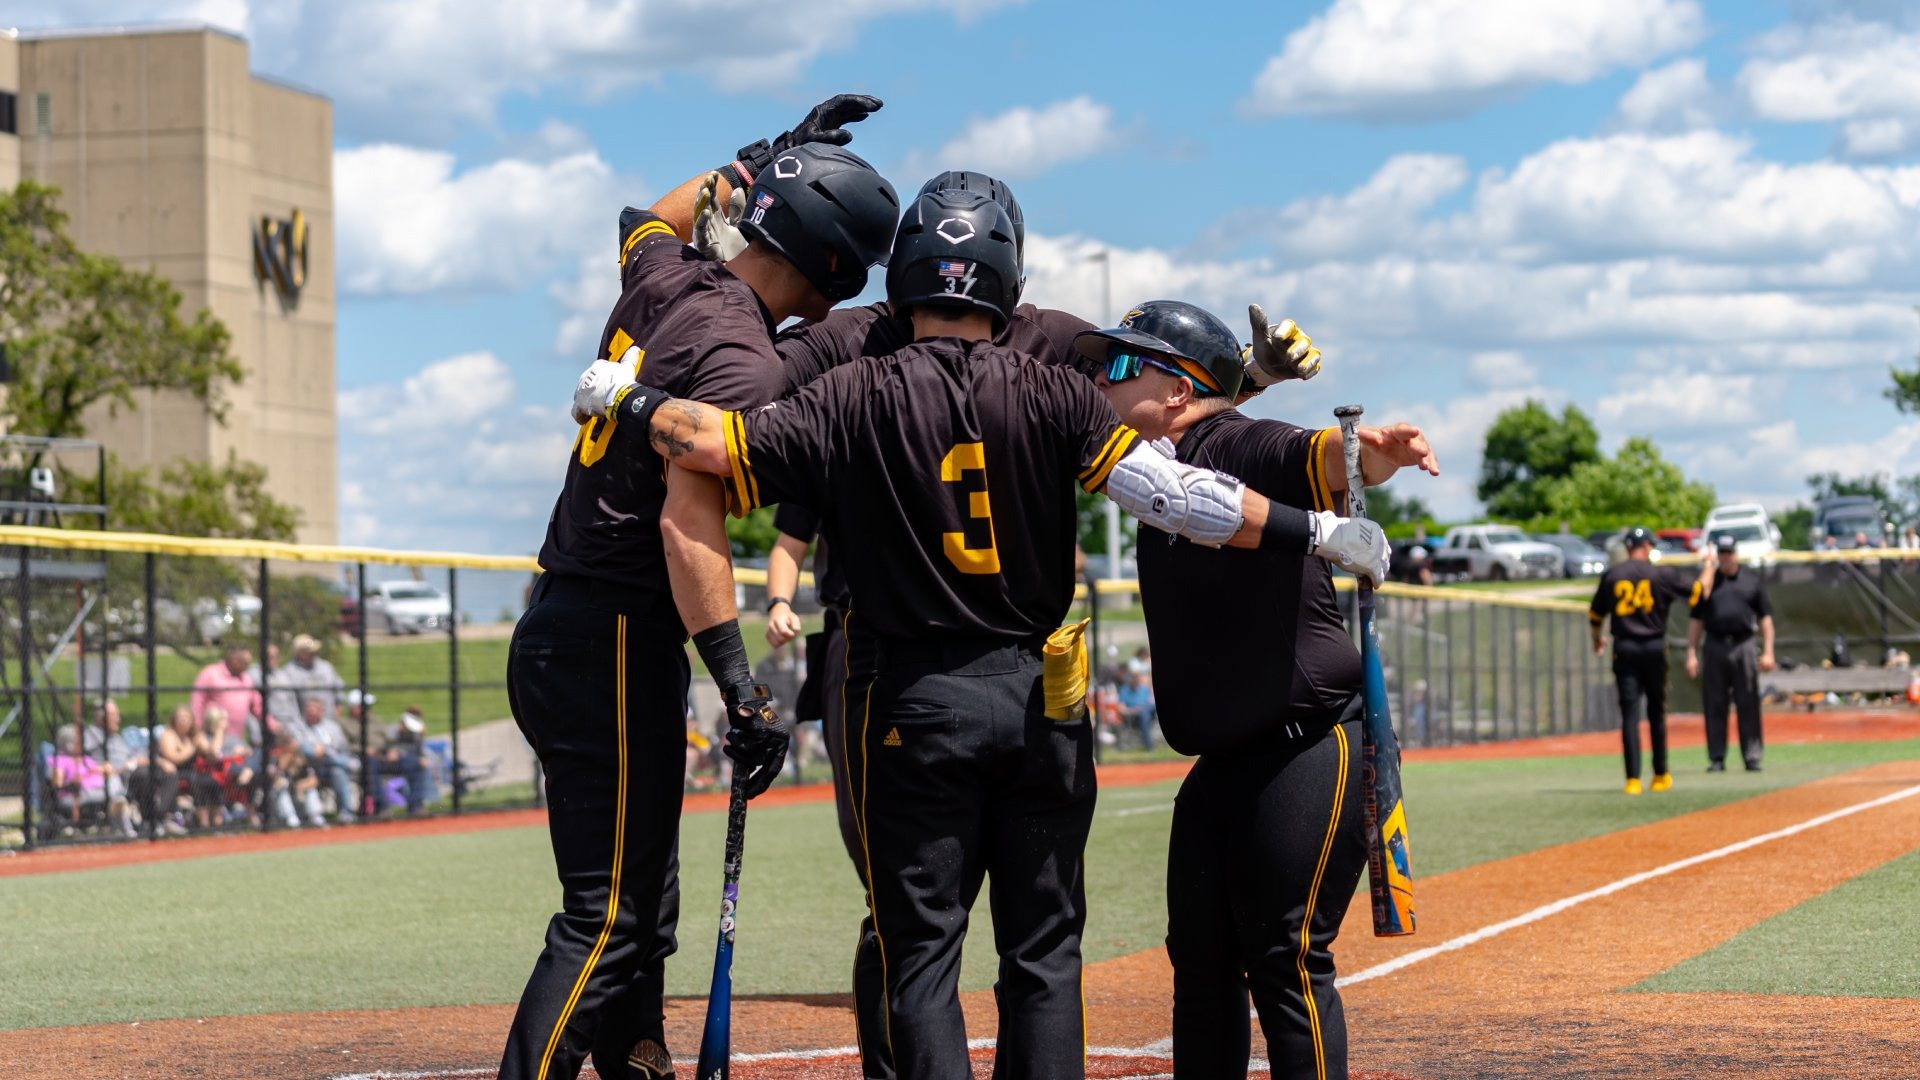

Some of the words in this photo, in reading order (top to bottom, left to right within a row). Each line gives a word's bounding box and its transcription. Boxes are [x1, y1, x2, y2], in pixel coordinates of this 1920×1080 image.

[750, 206, 765, 225] 10
[945, 277, 956, 294] 3
[941, 442, 1001, 574] 3
[1614, 578, 1655, 617] 24
